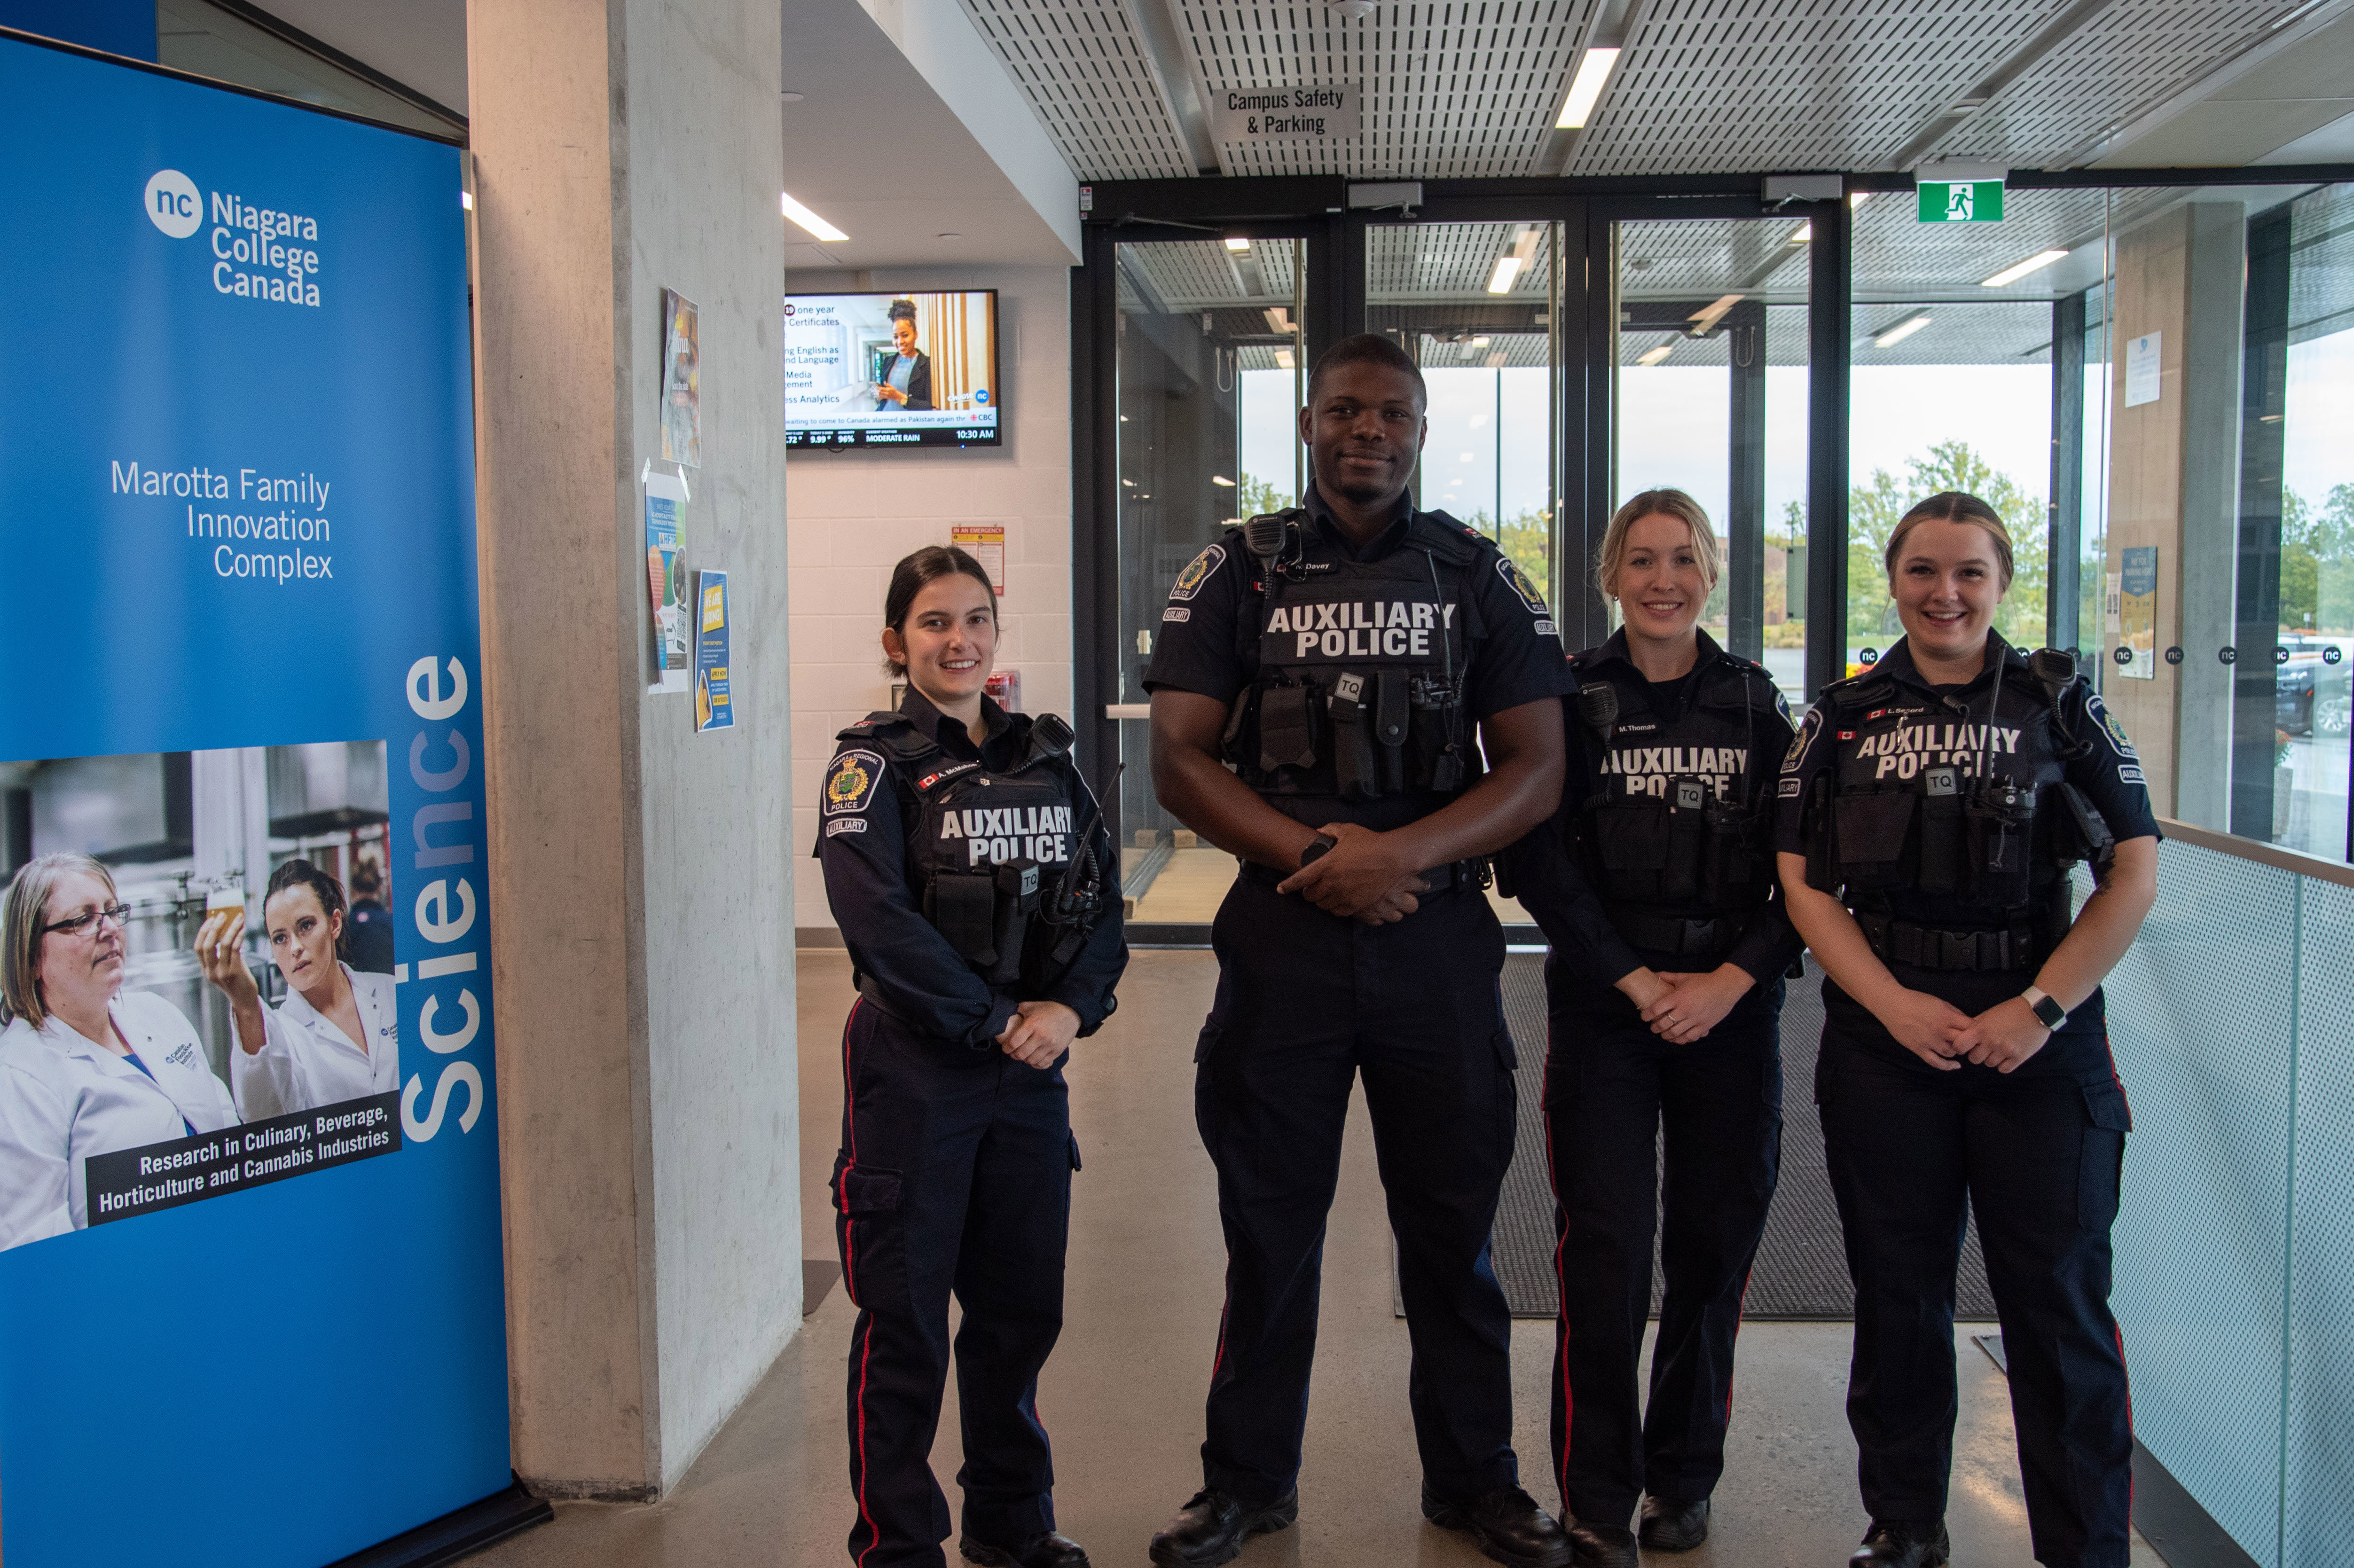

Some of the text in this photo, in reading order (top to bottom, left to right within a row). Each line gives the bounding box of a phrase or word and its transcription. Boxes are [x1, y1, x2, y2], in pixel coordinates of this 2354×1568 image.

[1228, 89, 1343, 113] Campus Safety
[1248, 114, 1325, 135] & Parking
[157, 190, 193, 218] nc
[212, 191, 318, 241] Niagara
[212, 227, 319, 278] College
[213, 261, 320, 307] Canada
[797, 346, 827, 355] English
[799, 356, 839, 365] Language
[800, 395, 840, 404] Analytics
[937, 415, 954, 423] again
[957, 430, 994, 439] 10:30 AM
[112, 461, 330, 511] Marotta Family
[188, 505, 330, 541] Innovation
[214, 545, 333, 585] Complex
[705, 592, 721, 608] WE ARE
[705, 608, 722, 625] HIRING!
[1166, 611, 1188, 619] AUXILIARY
[1267, 602, 1456, 633] AUXILIARY
[1296, 628, 1429, 657] POLICE
[1862, 652, 1875, 661] nc
[2117, 651, 2130, 660] nc
[2326, 651, 2338, 660] nc
[1342, 680, 1359, 695] TQ
[1857, 724, 2021, 759] AUXILIARY
[830, 753, 879, 771] NIAGARA REGIONAL
[1600, 747, 1747, 774] AUXILIARY
[1930, 776, 1951, 788] TQ
[1681, 789, 1699, 802] TQ
[831, 801, 858, 812] POLICE
[829, 821, 862, 834] AUXILIARY
[941, 806, 1071, 839] AUXILIARY
[1024, 875, 1036, 887] TQ
[395, 655, 484, 1143] Science
[141, 1105, 388, 1176] Research in Culinary, Beverage,
[100, 1129, 389, 1213] Horticulture and Cannabis Industries
